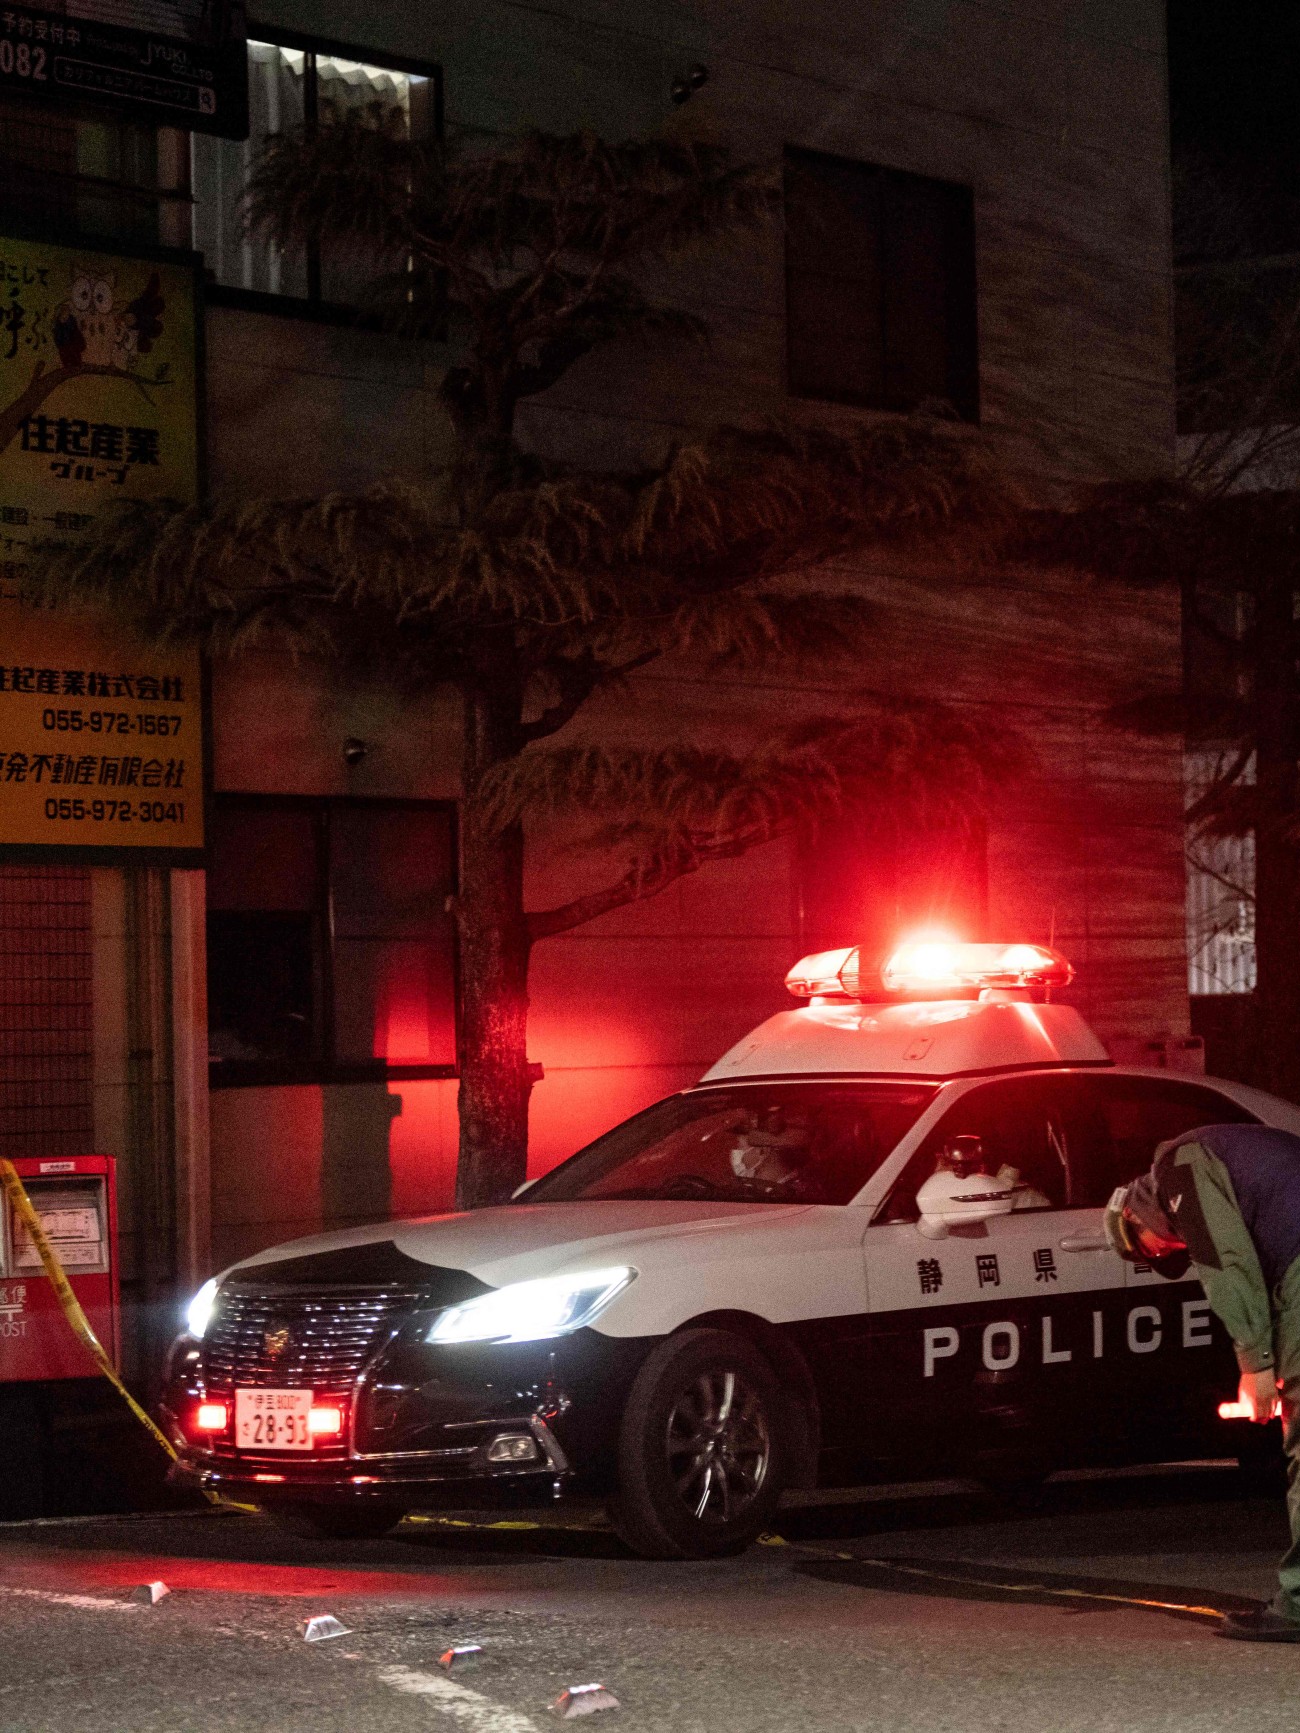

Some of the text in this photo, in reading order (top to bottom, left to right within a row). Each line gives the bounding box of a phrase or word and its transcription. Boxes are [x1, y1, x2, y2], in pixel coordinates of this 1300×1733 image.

[17, 413, 160, 466] 住起産業
[50, 459, 131, 485] グループ
[0, 751, 185, 788] 発不動産有限会社
[0, 1321, 28, 1338] OST
[922, 1298, 1214, 1379] POLICE
